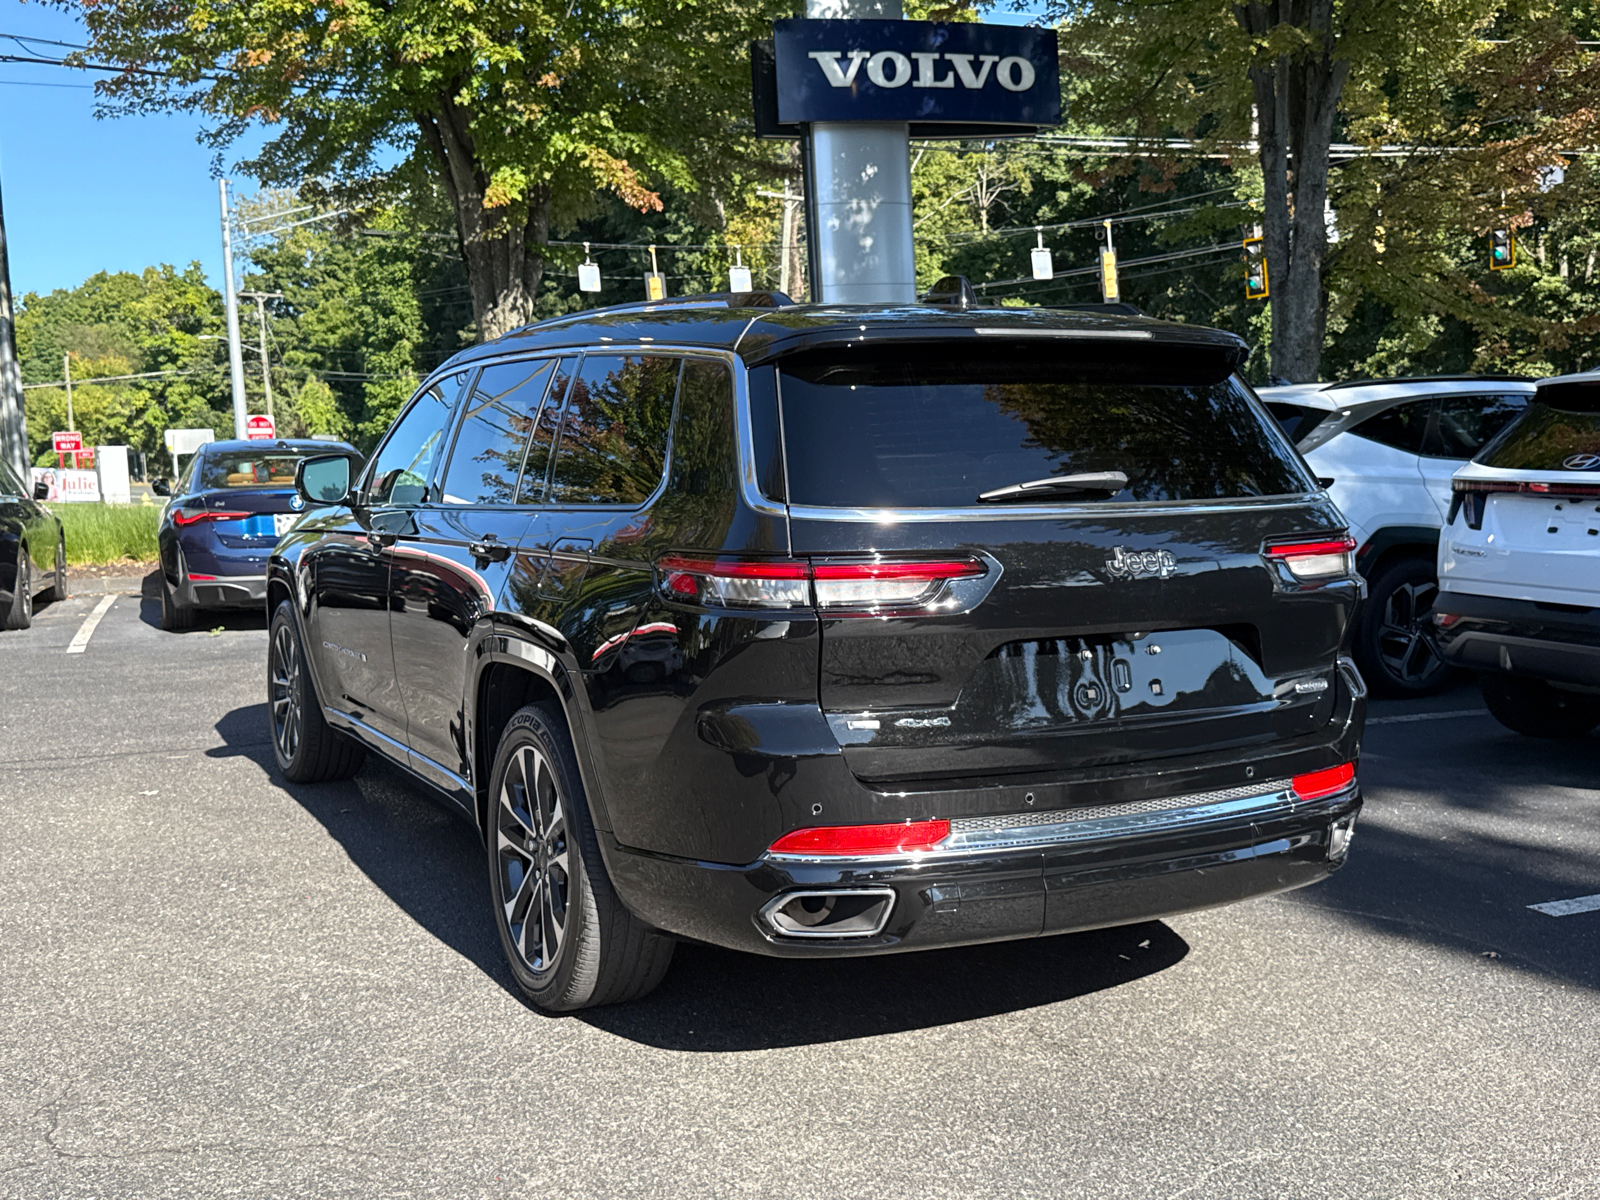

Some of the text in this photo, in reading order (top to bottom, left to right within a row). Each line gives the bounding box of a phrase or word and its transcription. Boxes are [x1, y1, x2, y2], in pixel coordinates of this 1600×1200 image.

[808, 51, 1036, 92] VOLVO
[62, 477, 95, 492] Julie
[1106, 545, 1177, 580] Jeep
